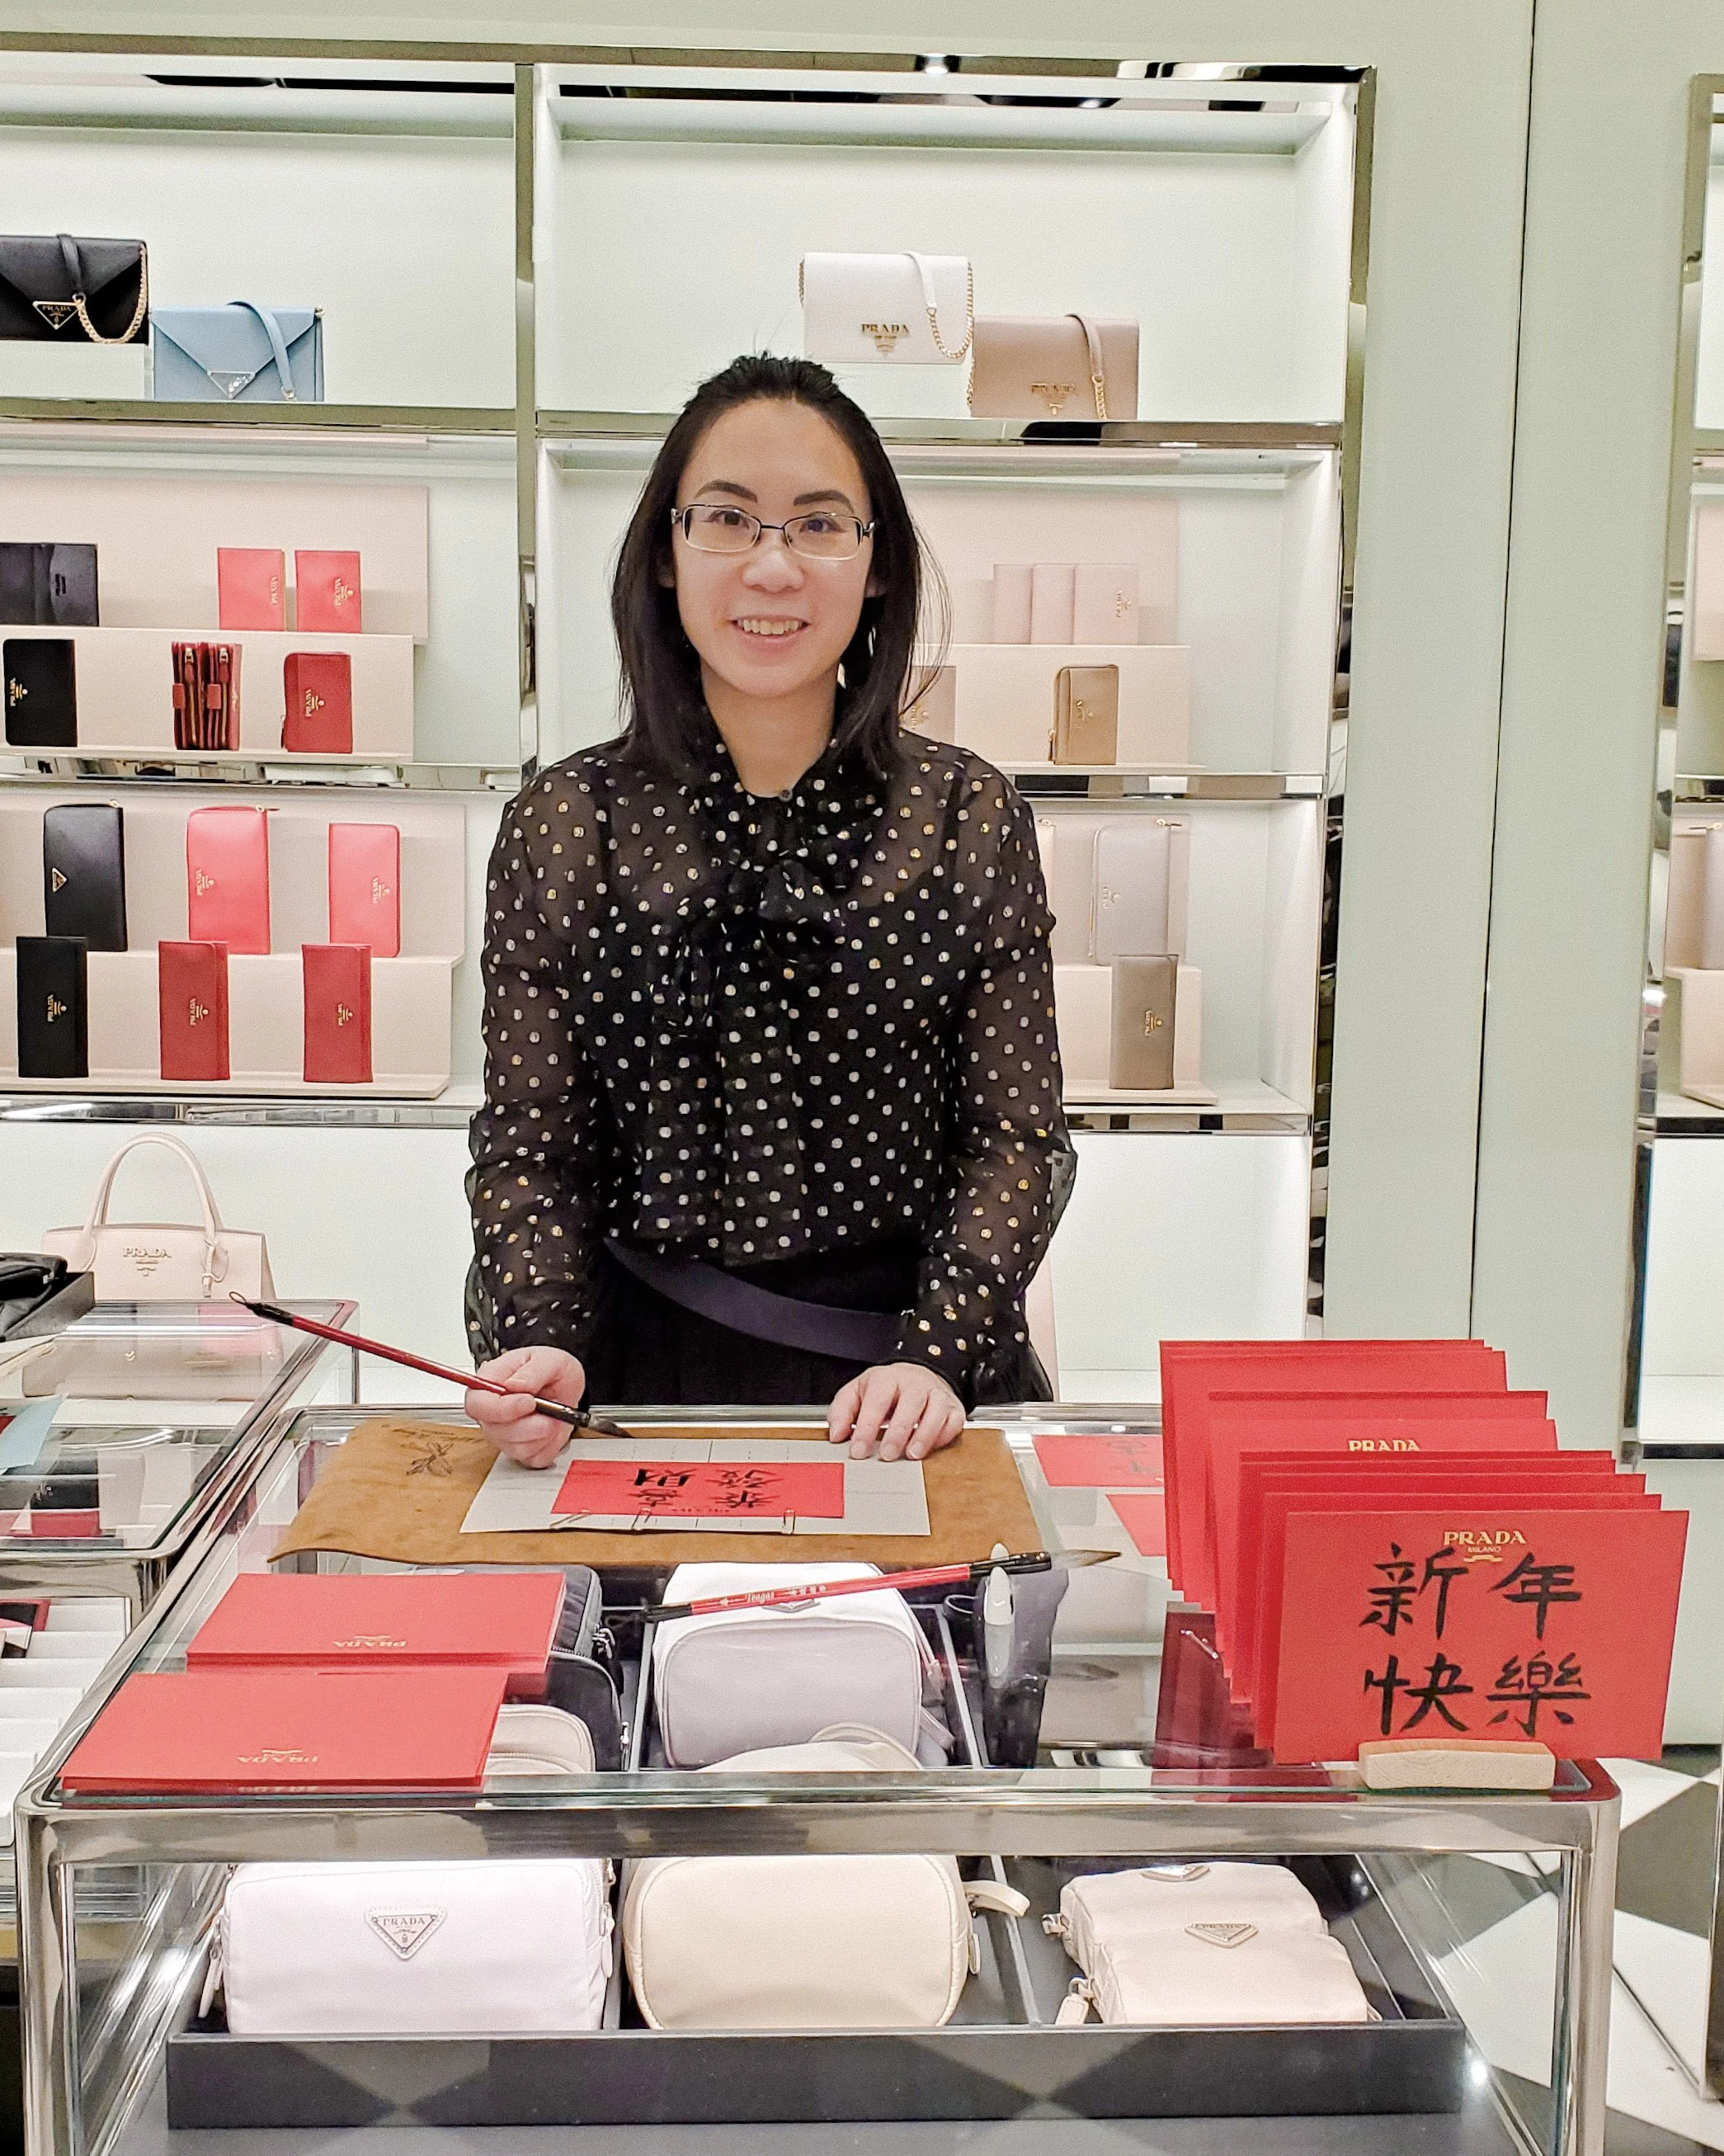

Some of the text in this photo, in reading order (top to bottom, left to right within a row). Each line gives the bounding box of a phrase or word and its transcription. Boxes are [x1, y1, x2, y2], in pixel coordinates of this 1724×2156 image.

[861, 323, 910, 333] PRADA
[123, 1248, 172, 1258] PRADA
[1348, 1440, 1421, 1452] PRADA
[1444, 1531, 1527, 1545] PRADA
[1359, 1541, 1583, 1640] 新年
[1363, 1650, 1592, 1738] 快樂
[383, 1917, 426, 1926] PRADA
